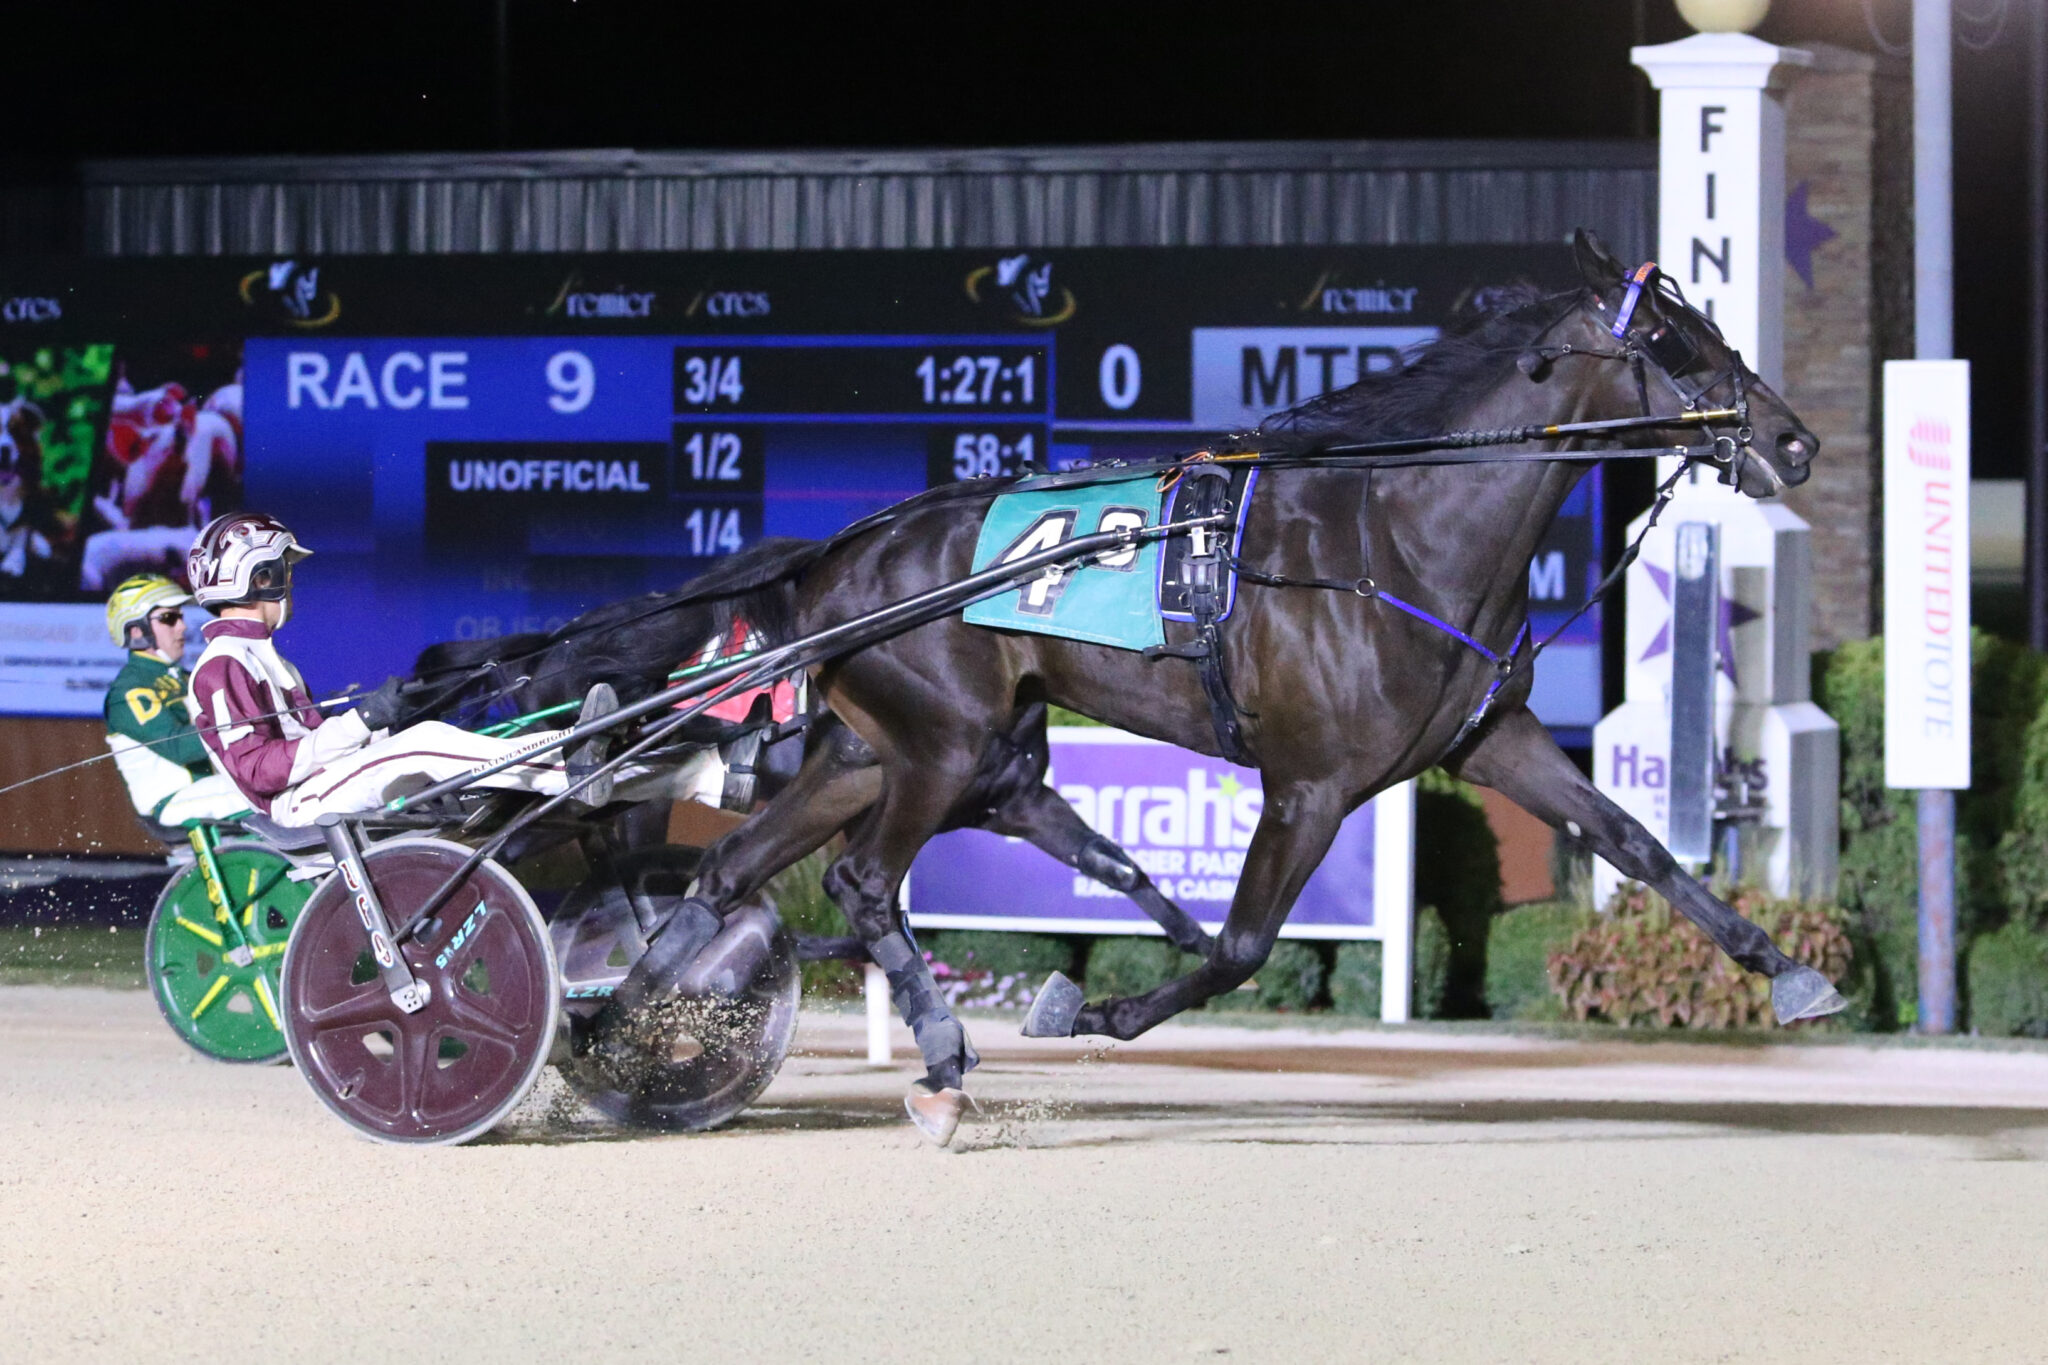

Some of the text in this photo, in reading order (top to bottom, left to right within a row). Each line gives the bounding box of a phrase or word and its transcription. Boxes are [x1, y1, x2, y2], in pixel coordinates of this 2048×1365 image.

[287, 350, 595, 413] RACE 9
[685, 356, 1034, 404] 3/4 1:27:1
[1100, 343, 1141, 410] 0
[450, 459, 650, 492] UNOFFICIAL
[685, 433, 1034, 480] 1/2 58:1
[685, 508, 743, 556] 1/4
[1190, 852, 1248, 876] PAR
